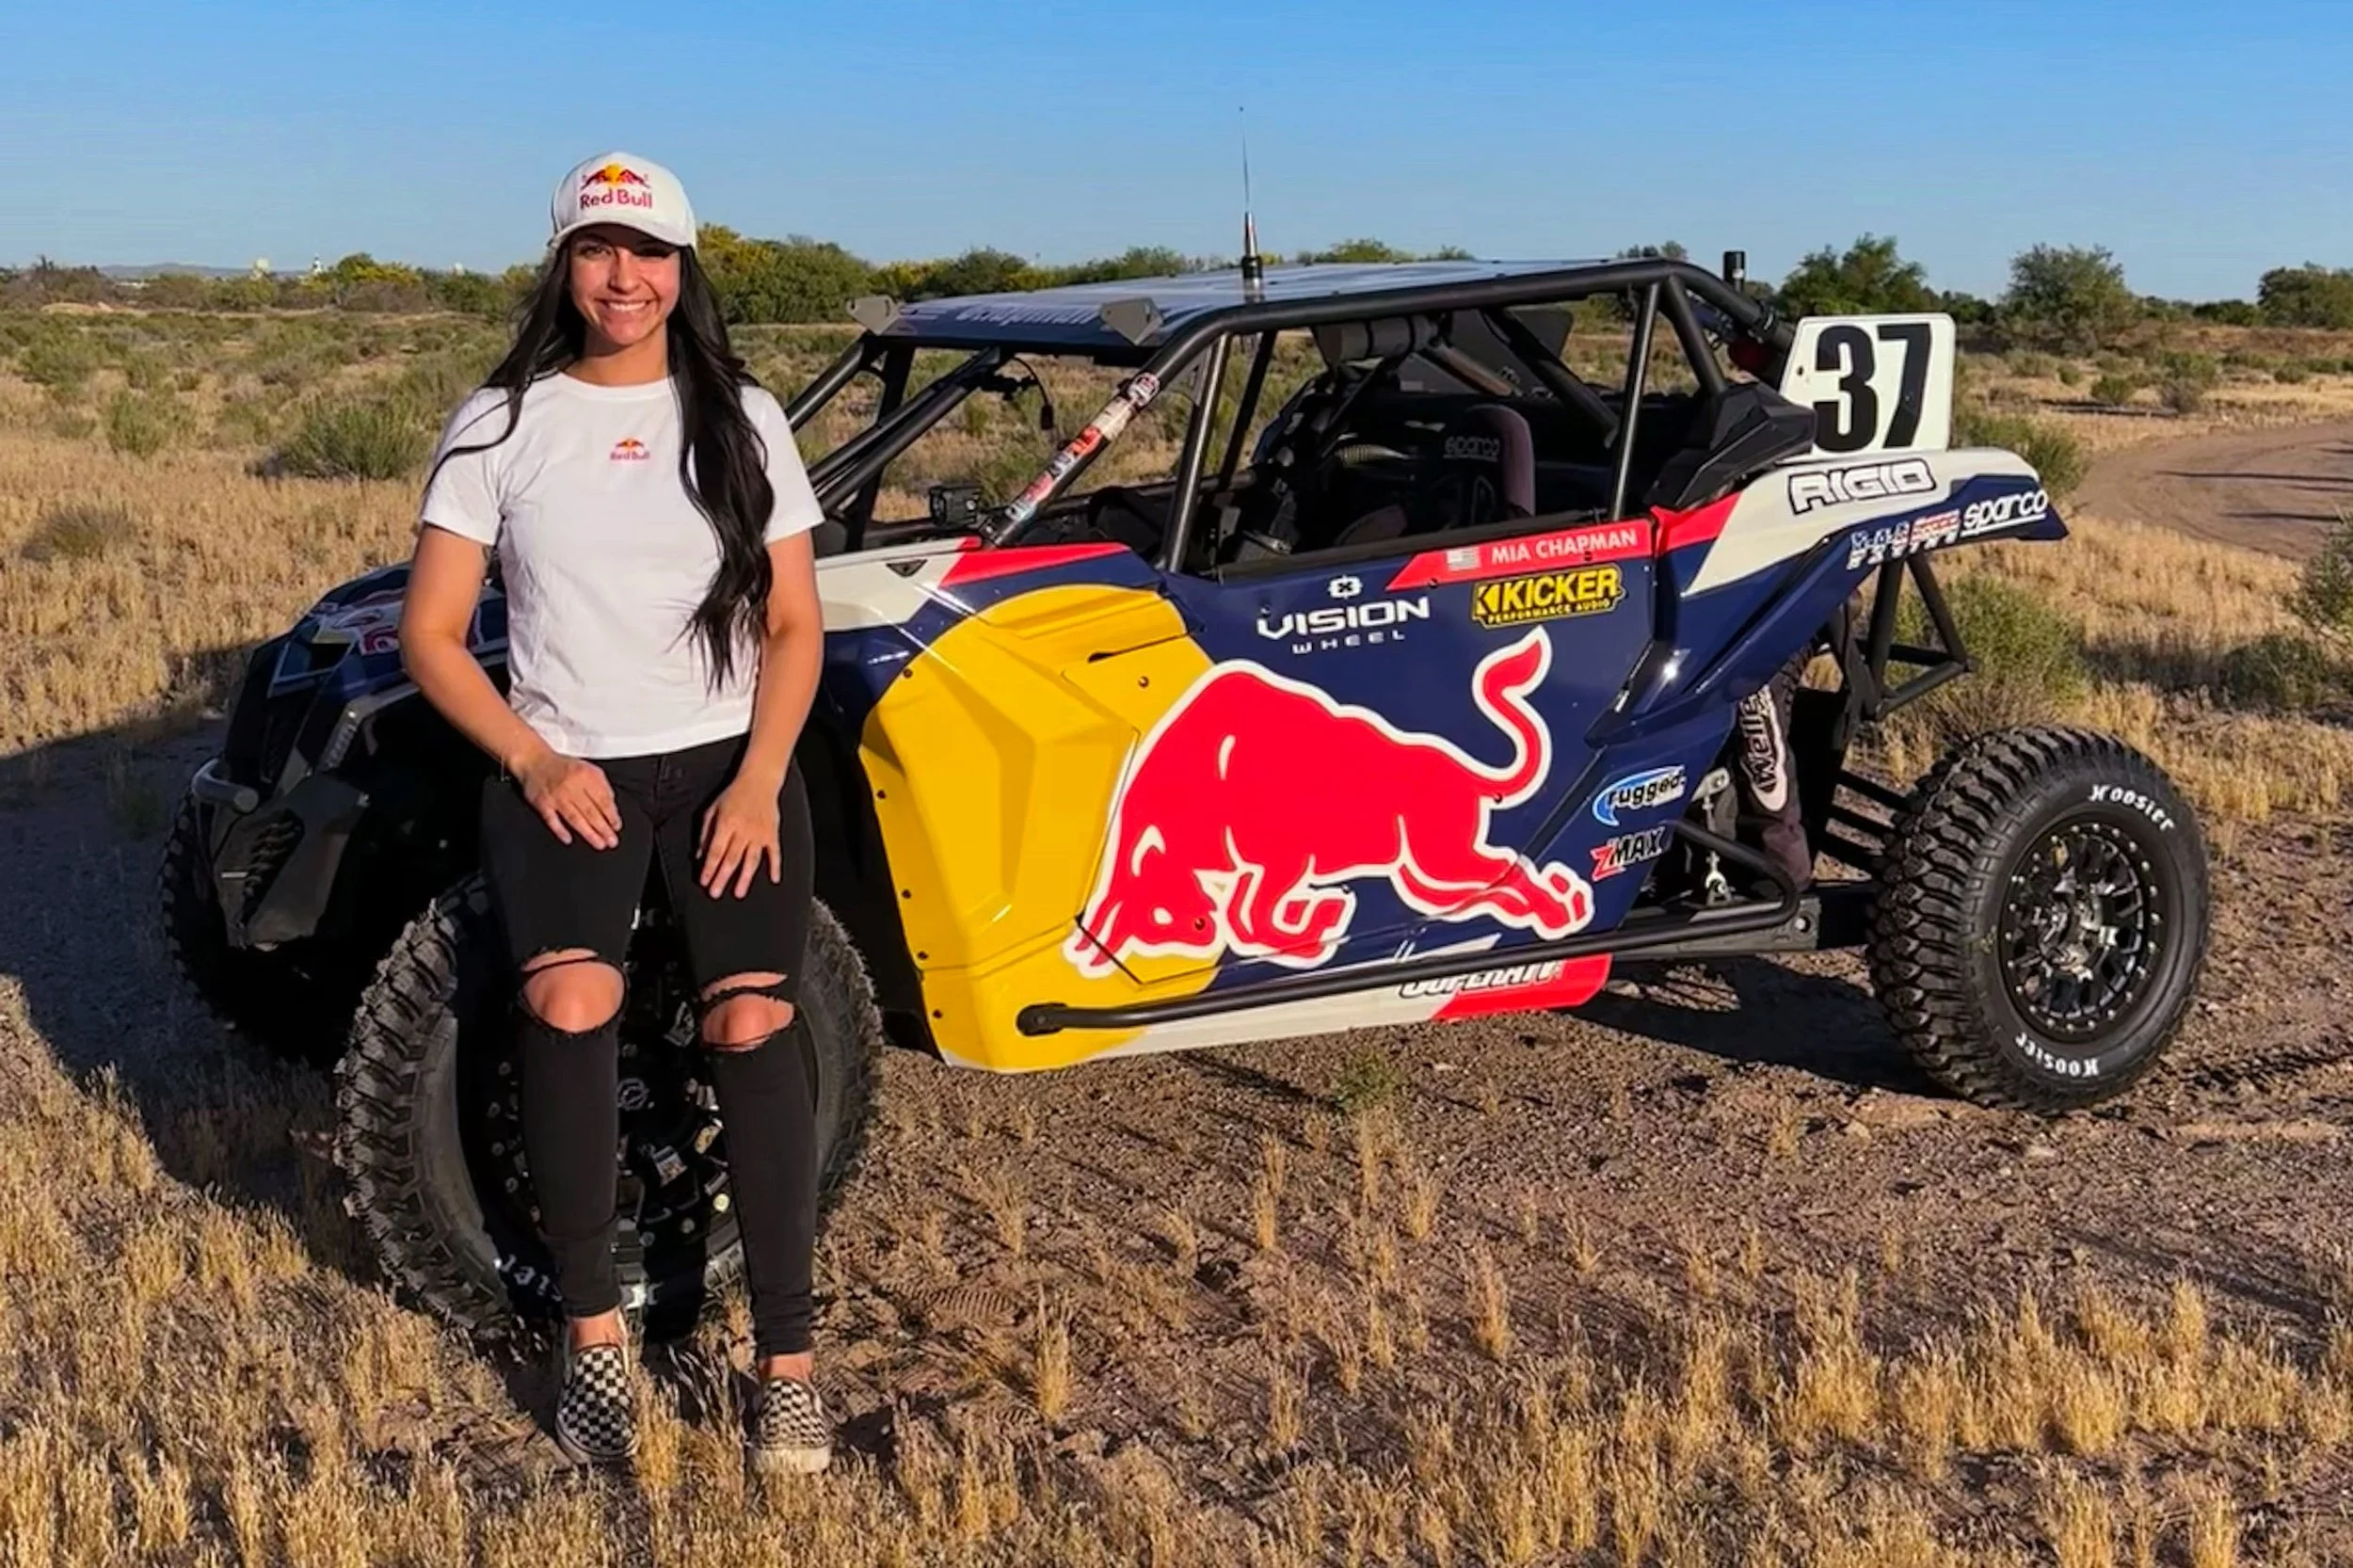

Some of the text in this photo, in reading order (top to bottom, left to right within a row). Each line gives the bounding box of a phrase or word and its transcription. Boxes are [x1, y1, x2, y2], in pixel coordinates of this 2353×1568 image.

[580, 188, 652, 210] Red Bull
[1813, 324, 1932, 454] 37
[610, 451, 650, 460] Red Bull
[1789, 459, 1936, 515] RIGID
[1963, 489, 2049, 532] sparco
[1492, 529, 1638, 565] MIA CHAPMAN
[1257, 596, 1430, 640] VISION
[1488, 599, 1610, 624] PERFORMANCE AUDIO
[1292, 630, 1405, 654] WHEEL
